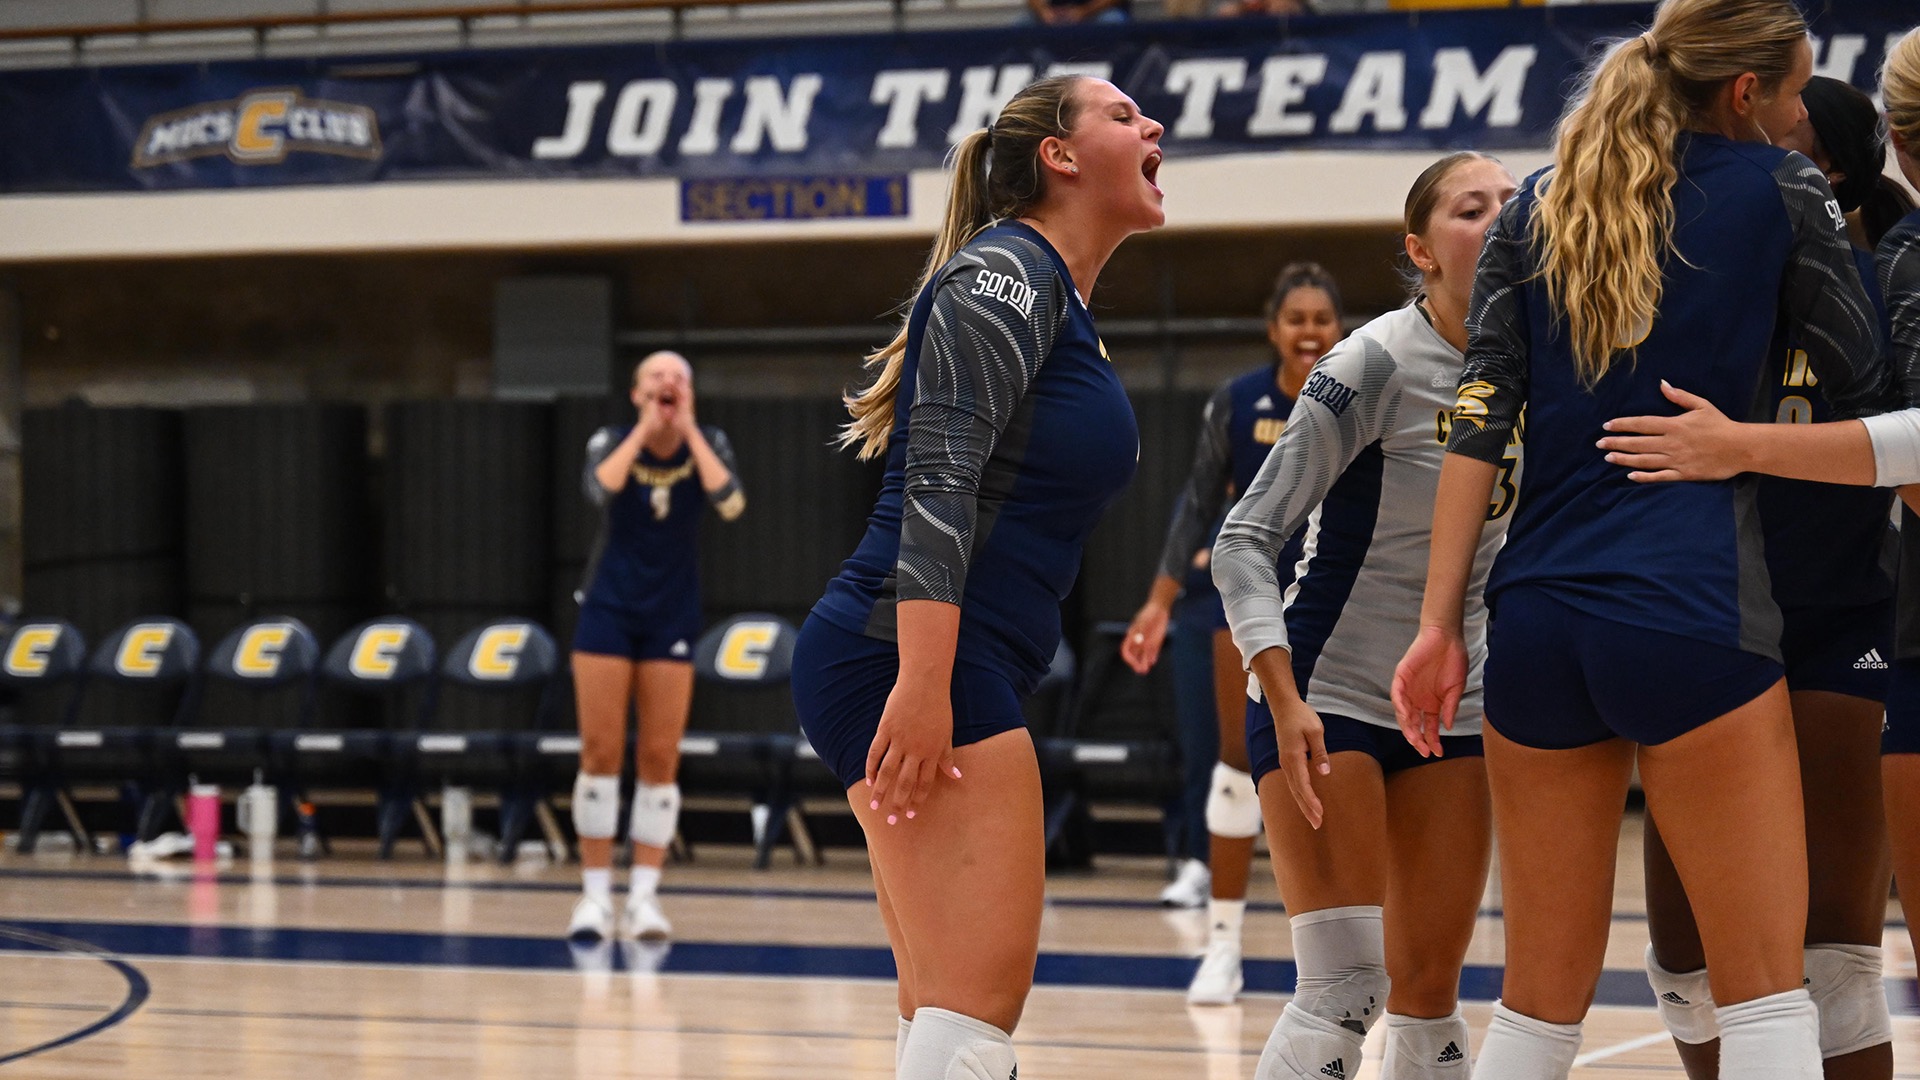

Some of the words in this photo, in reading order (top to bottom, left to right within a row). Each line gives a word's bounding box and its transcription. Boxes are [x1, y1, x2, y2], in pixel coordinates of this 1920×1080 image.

[532, 74, 821, 158] JOIN
[869, 61, 1112, 149] TH
[1165, 45, 1538, 138] TEAM
[687, 180, 867, 220] SECTION
[971, 269, 1038, 320] SOCON
[1301, 370, 1358, 418] SOCON
[3, 624, 62, 677] C
[115, 623, 175, 677] C
[232, 623, 294, 678] C
[349, 624, 411, 679] C
[468, 624, 530, 680] C
[714, 621, 781, 679] C
[1853, 661, 1888, 669] adidas
[1437, 1052, 1463, 1062] adidas
